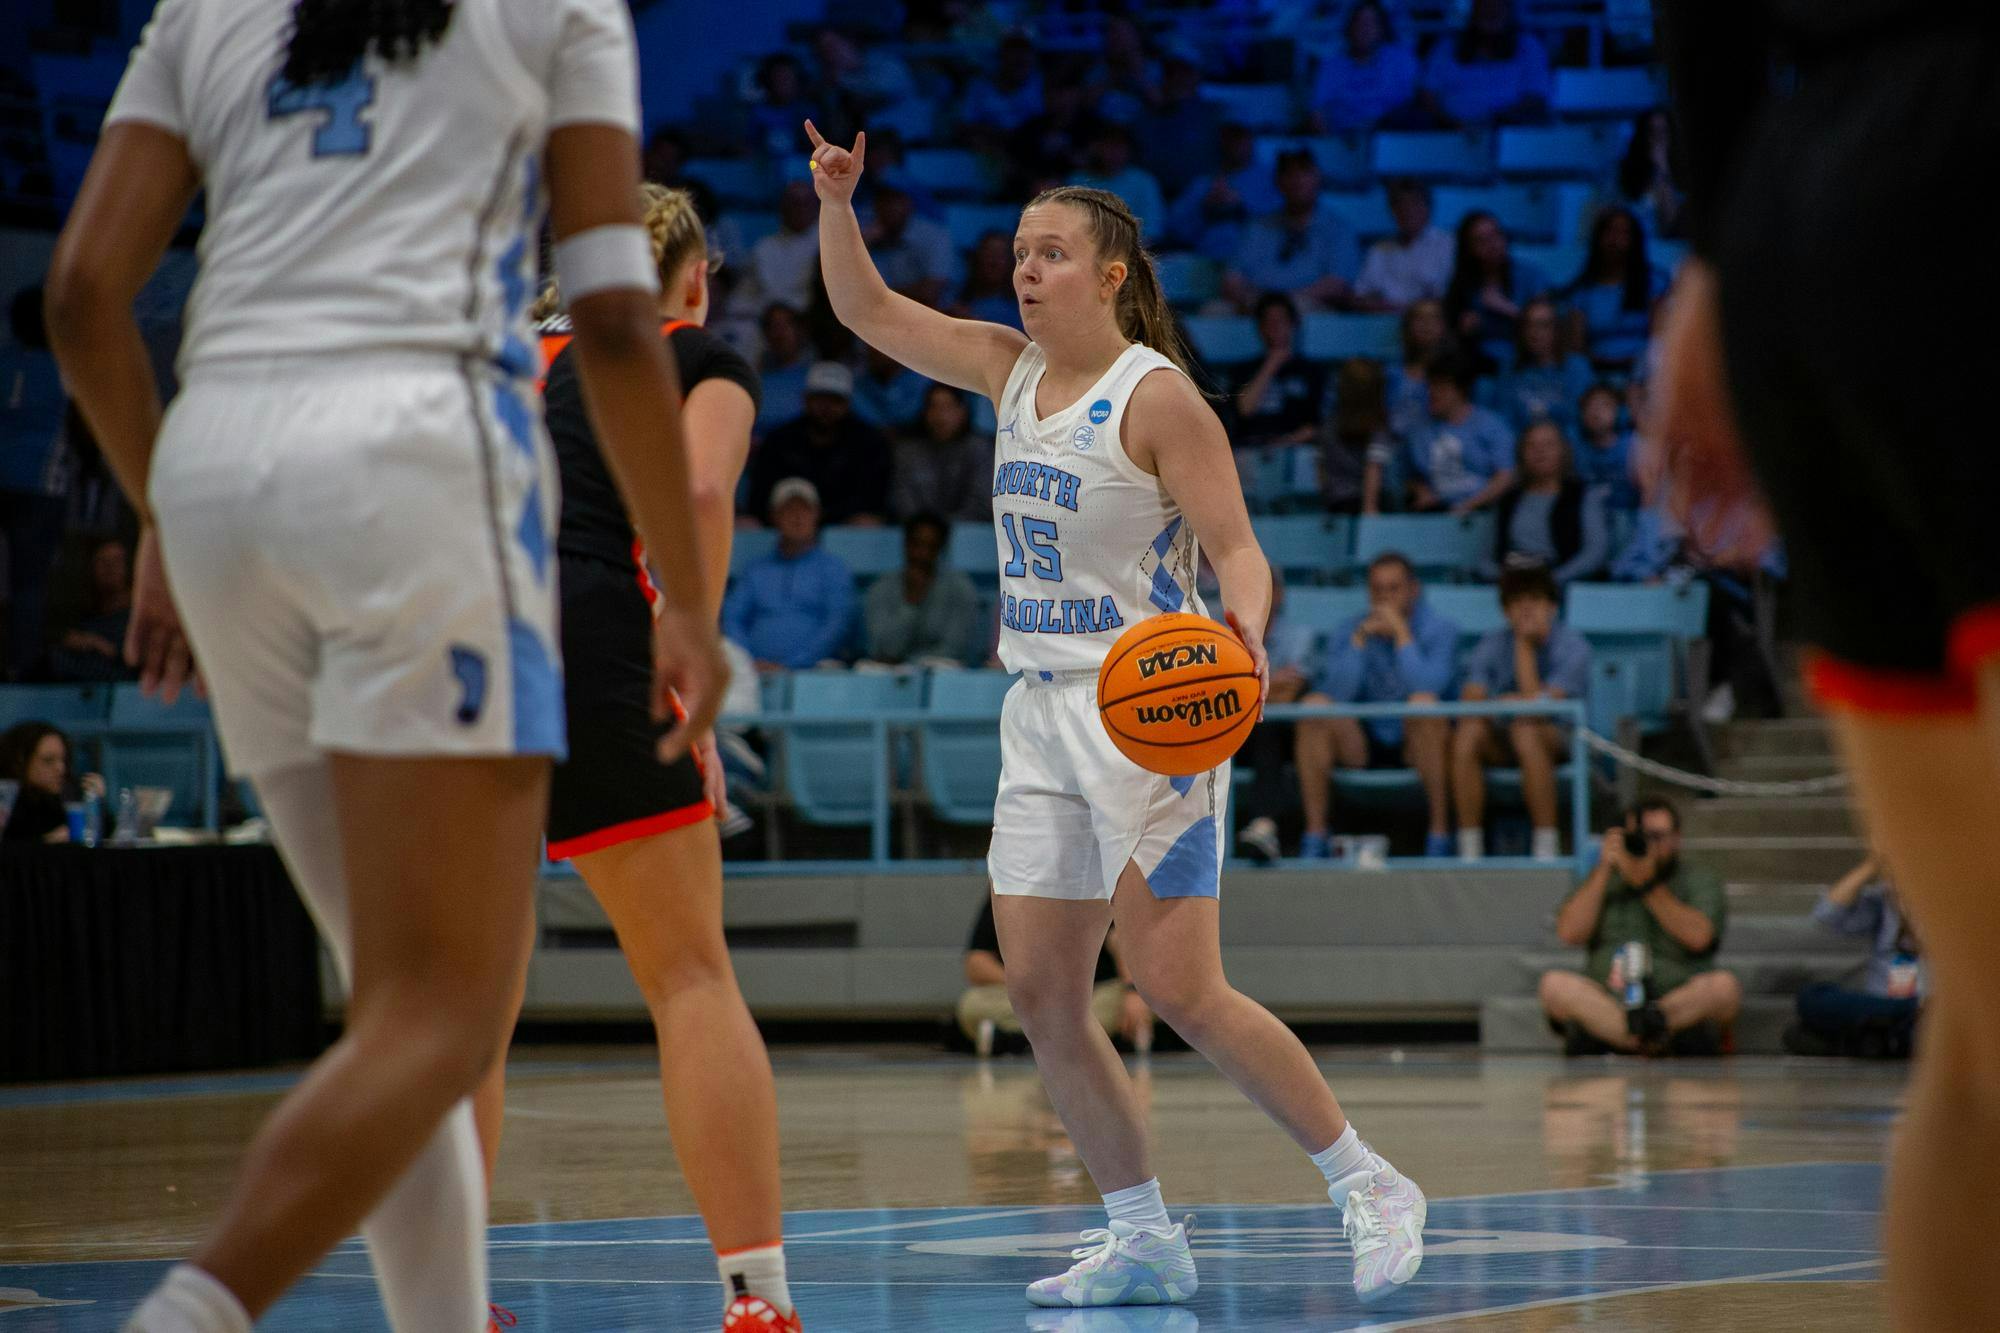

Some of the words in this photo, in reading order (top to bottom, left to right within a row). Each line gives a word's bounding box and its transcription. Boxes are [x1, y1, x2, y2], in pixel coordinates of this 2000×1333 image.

[266, 56, 374, 157] 4
[992, 461, 1081, 512] NORTH
[1001, 513, 1063, 583] 15
[1001, 590, 1124, 634] AROLINA
[1137, 644, 1217, 679] NCAA
[1136, 688, 1242, 727] Wilson
